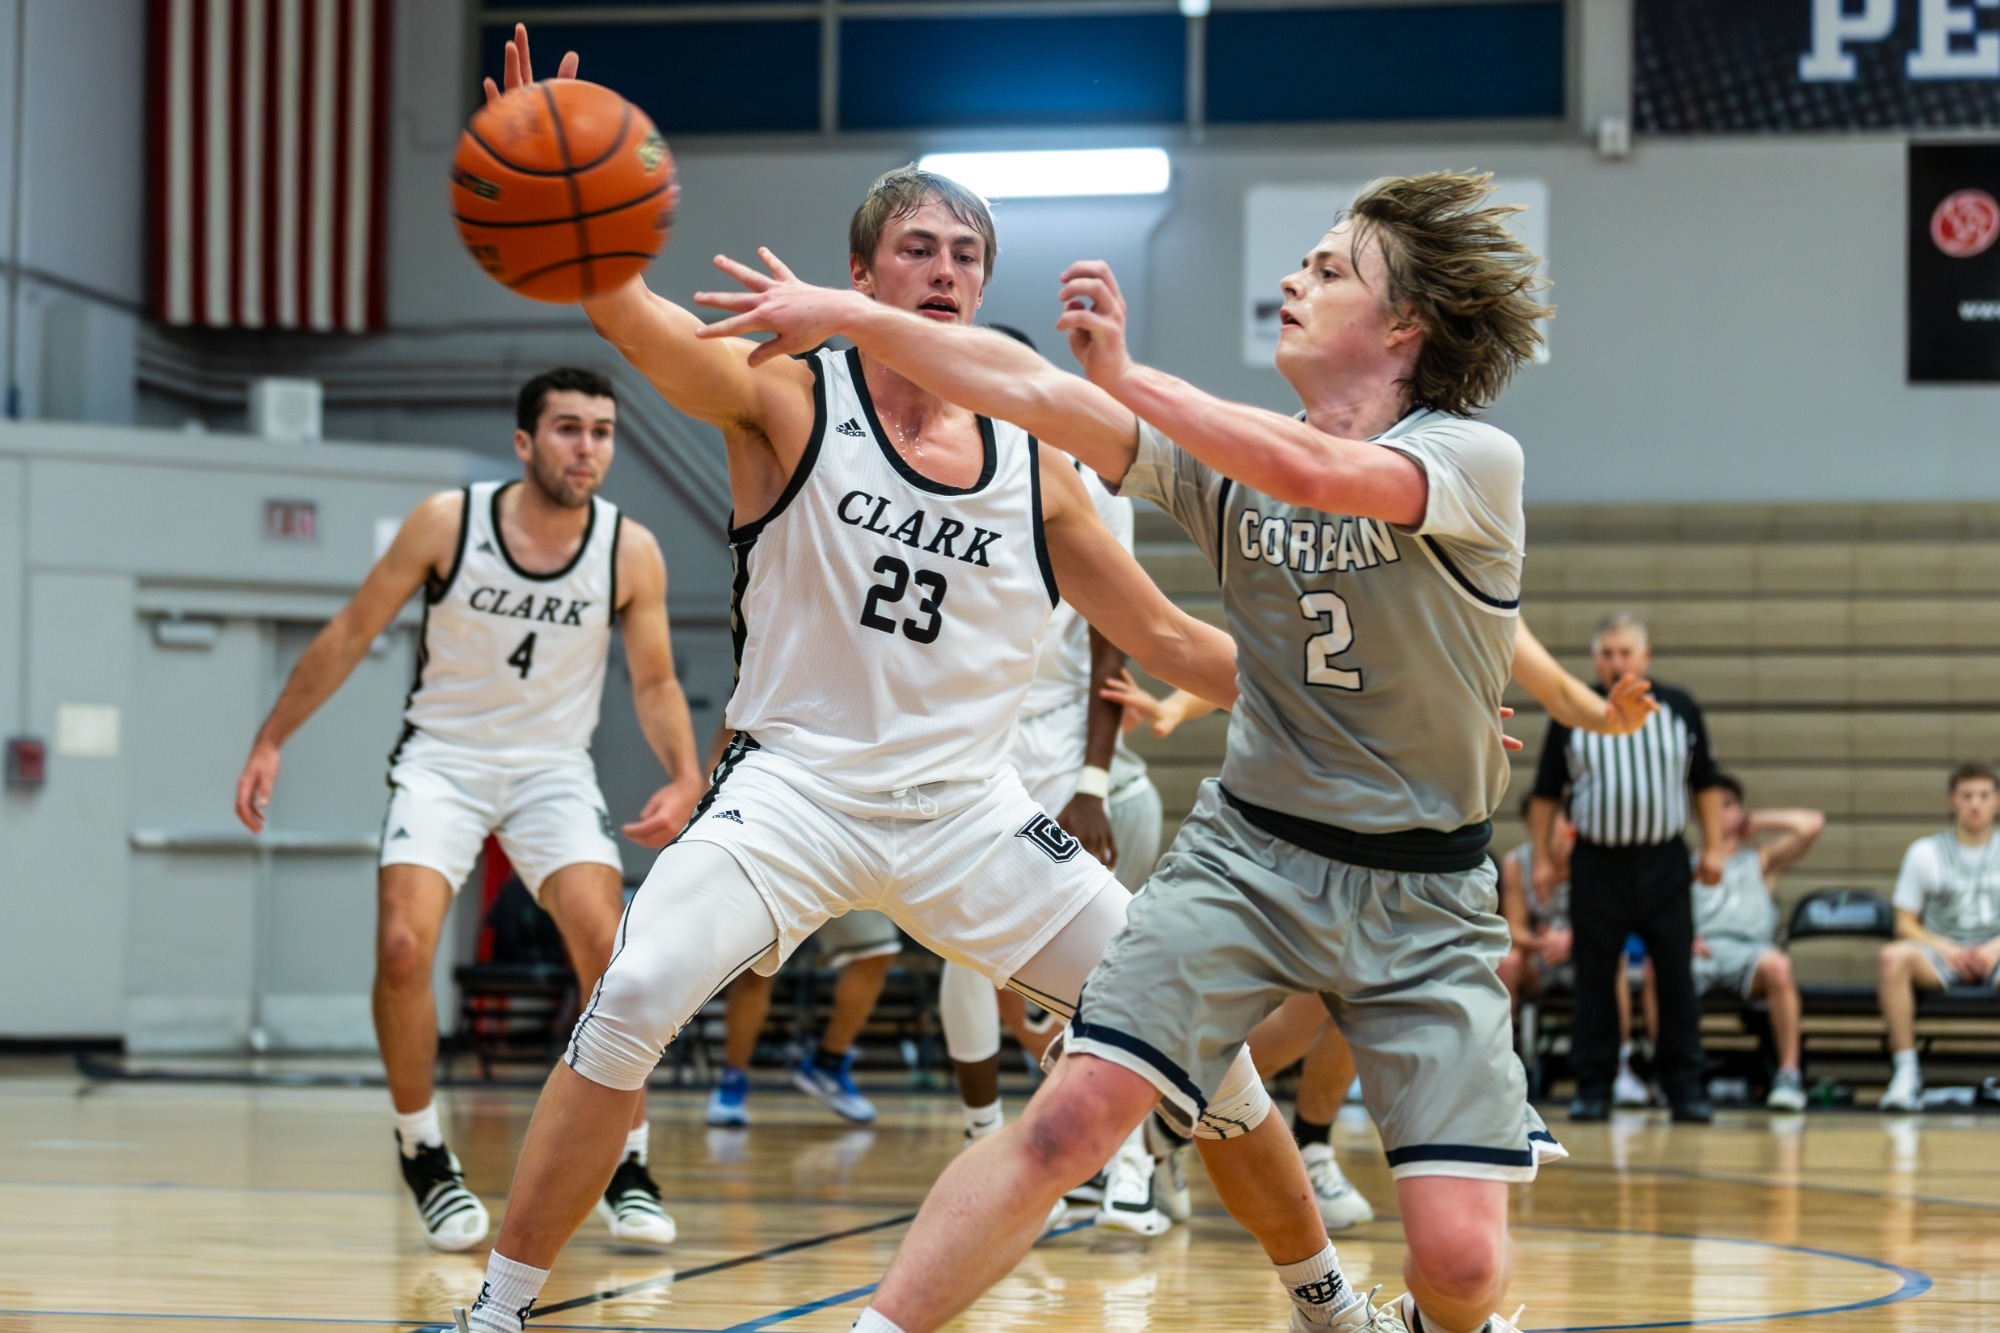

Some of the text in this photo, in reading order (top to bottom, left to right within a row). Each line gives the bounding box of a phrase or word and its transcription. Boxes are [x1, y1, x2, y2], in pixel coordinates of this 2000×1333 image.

[835, 426, 866, 437] adidas
[837, 490, 1002, 568] CLARK
[469, 586, 591, 626] CLARK
[860, 555, 947, 644] 23
[507, 630, 537, 680] 4
[1298, 589, 1363, 691] 2
